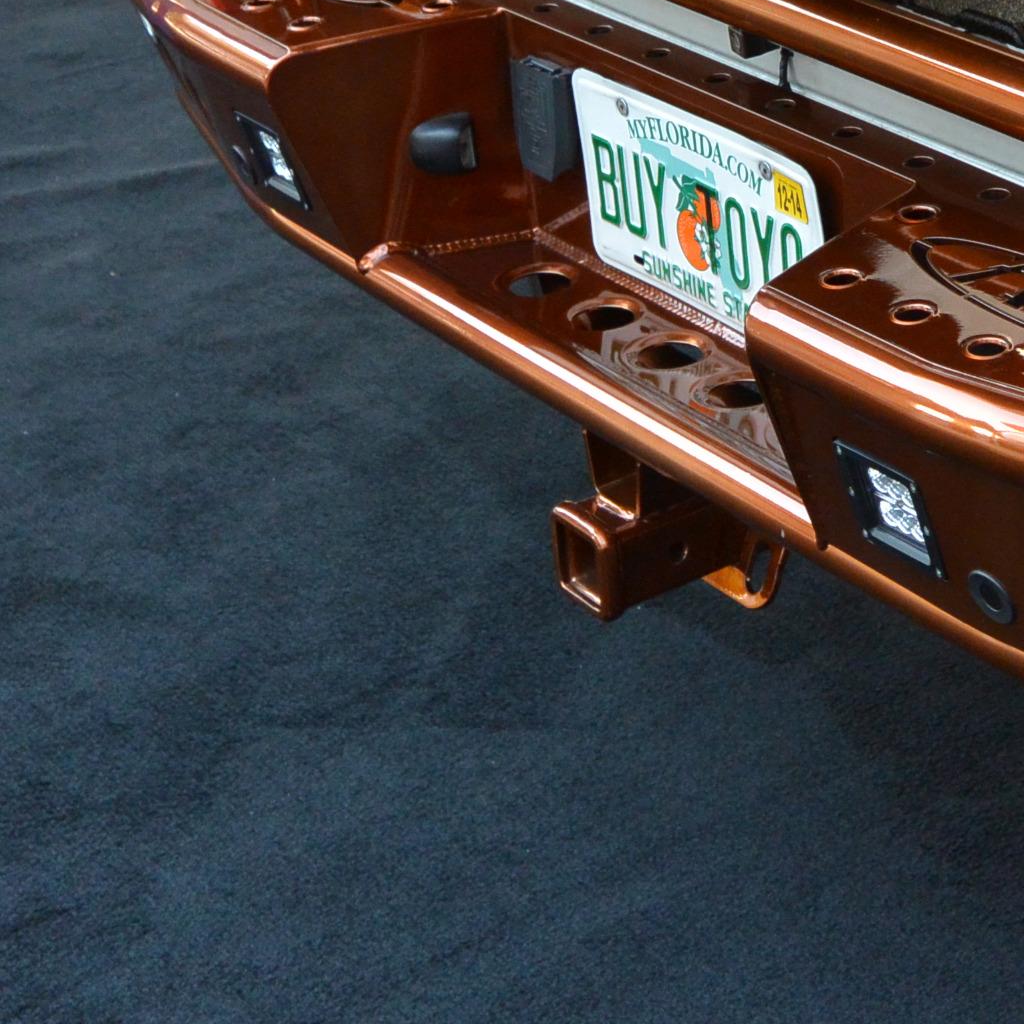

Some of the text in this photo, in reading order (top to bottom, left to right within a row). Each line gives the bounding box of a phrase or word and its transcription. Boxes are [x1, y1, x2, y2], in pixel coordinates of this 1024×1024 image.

[591, 133, 667, 249] BUY
[777, 183, 803, 218] 12-14
[642, 250, 717, 310] SUNSHINE
